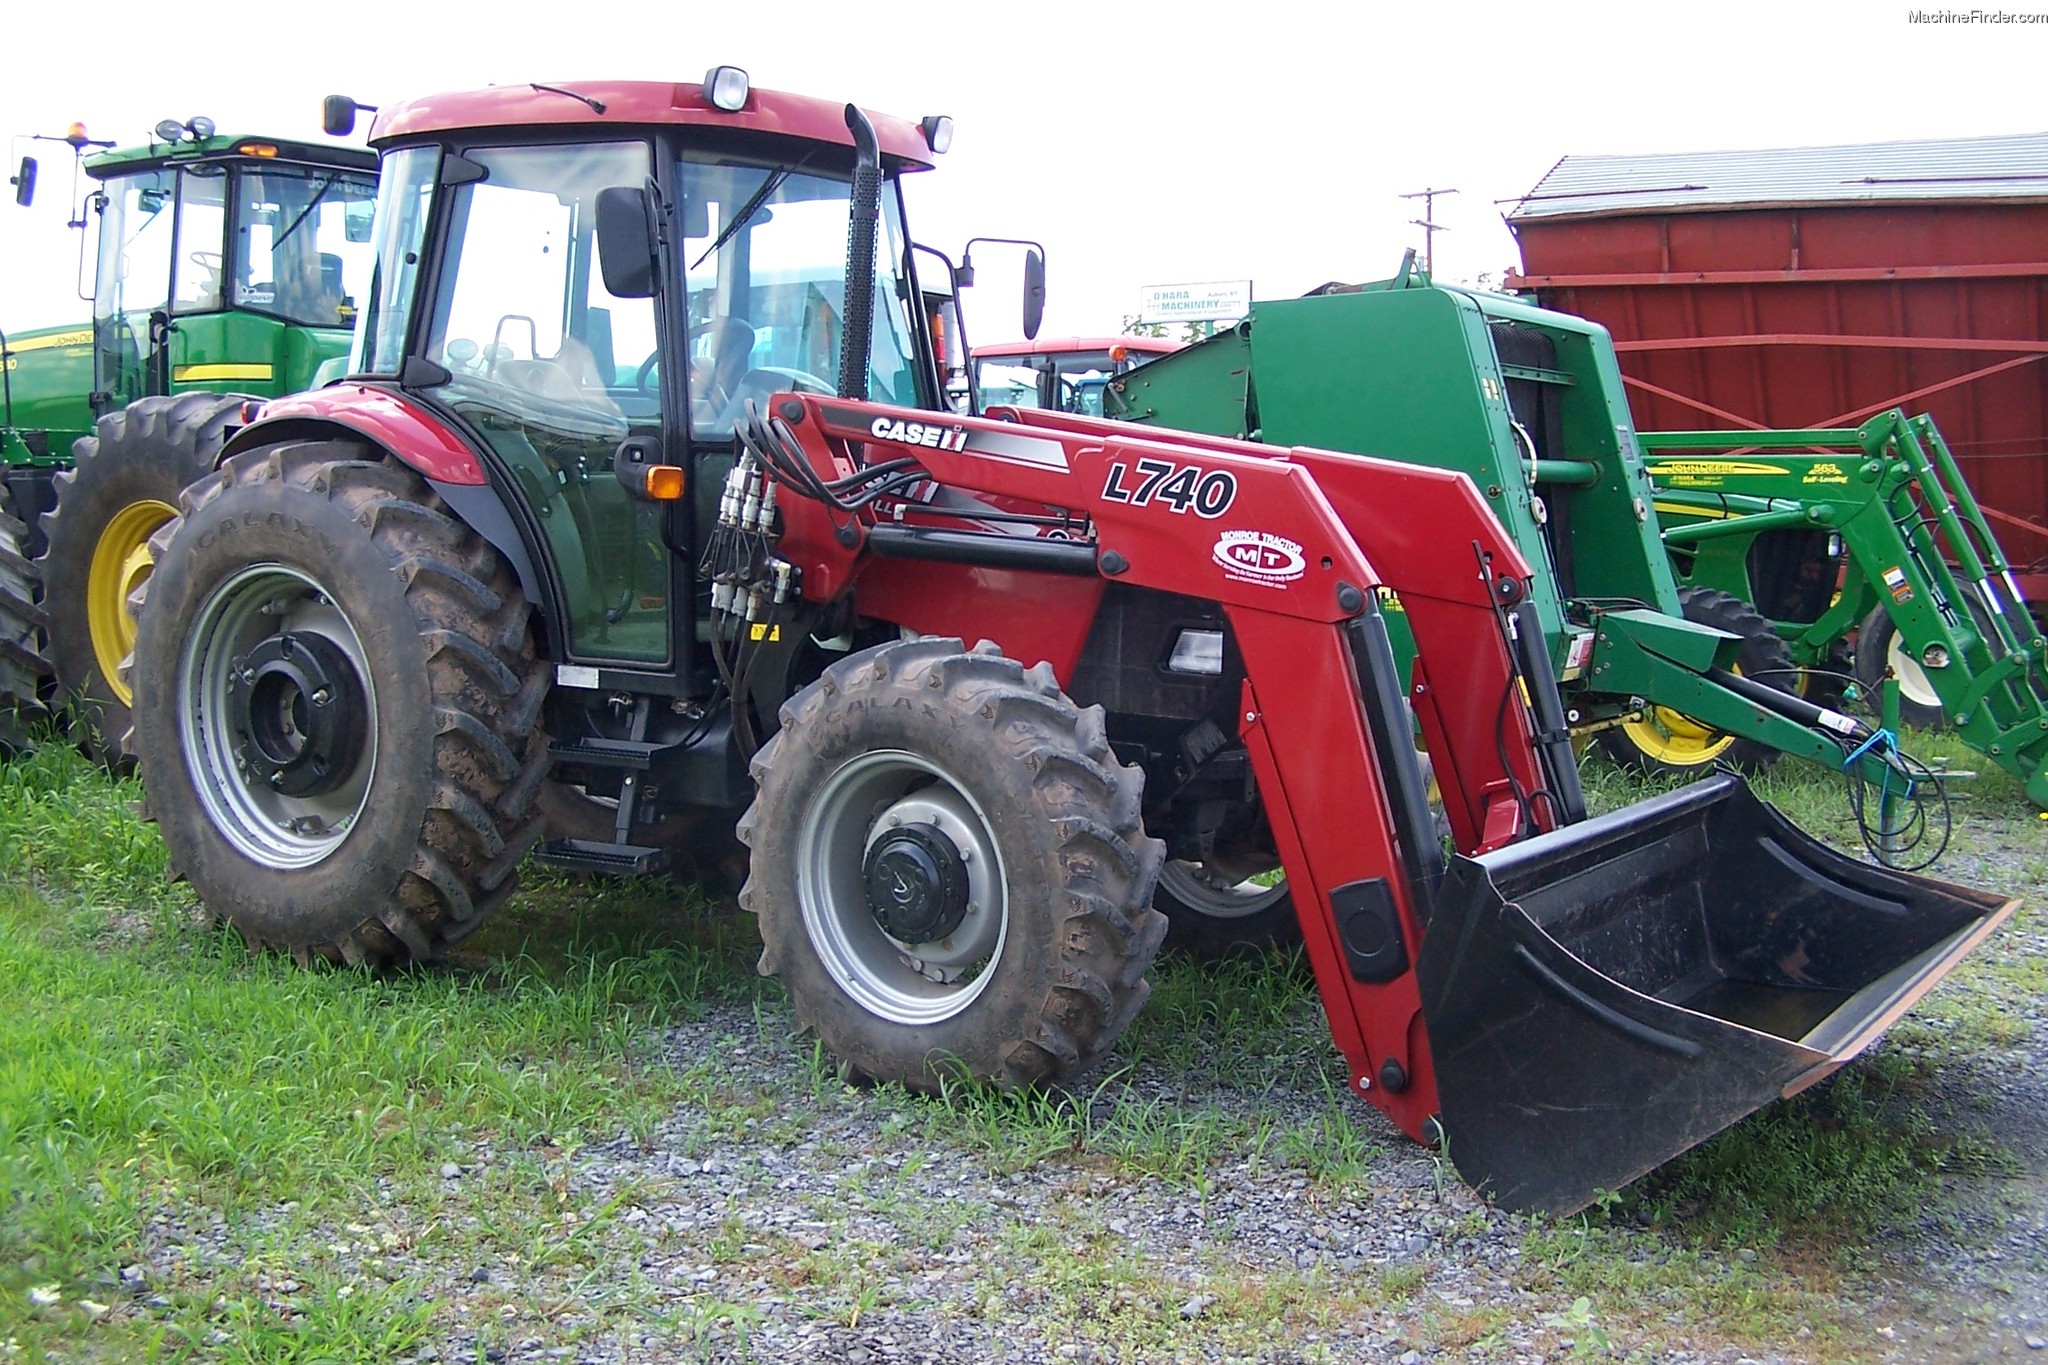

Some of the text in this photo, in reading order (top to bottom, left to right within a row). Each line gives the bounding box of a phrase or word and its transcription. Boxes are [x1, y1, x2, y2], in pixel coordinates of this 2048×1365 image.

[1161, 300, 1219, 310] MACHINERY
[1667, 463, 1734, 473] JOHN DEERE
[1814, 463, 1836, 473] 563
[1101, 457, 1237, 519] L740
[198, 510, 343, 556] GALAXY
[1220, 530, 1303, 555] MONROE TRACTOR
[824, 697, 967, 747] GALAXY
